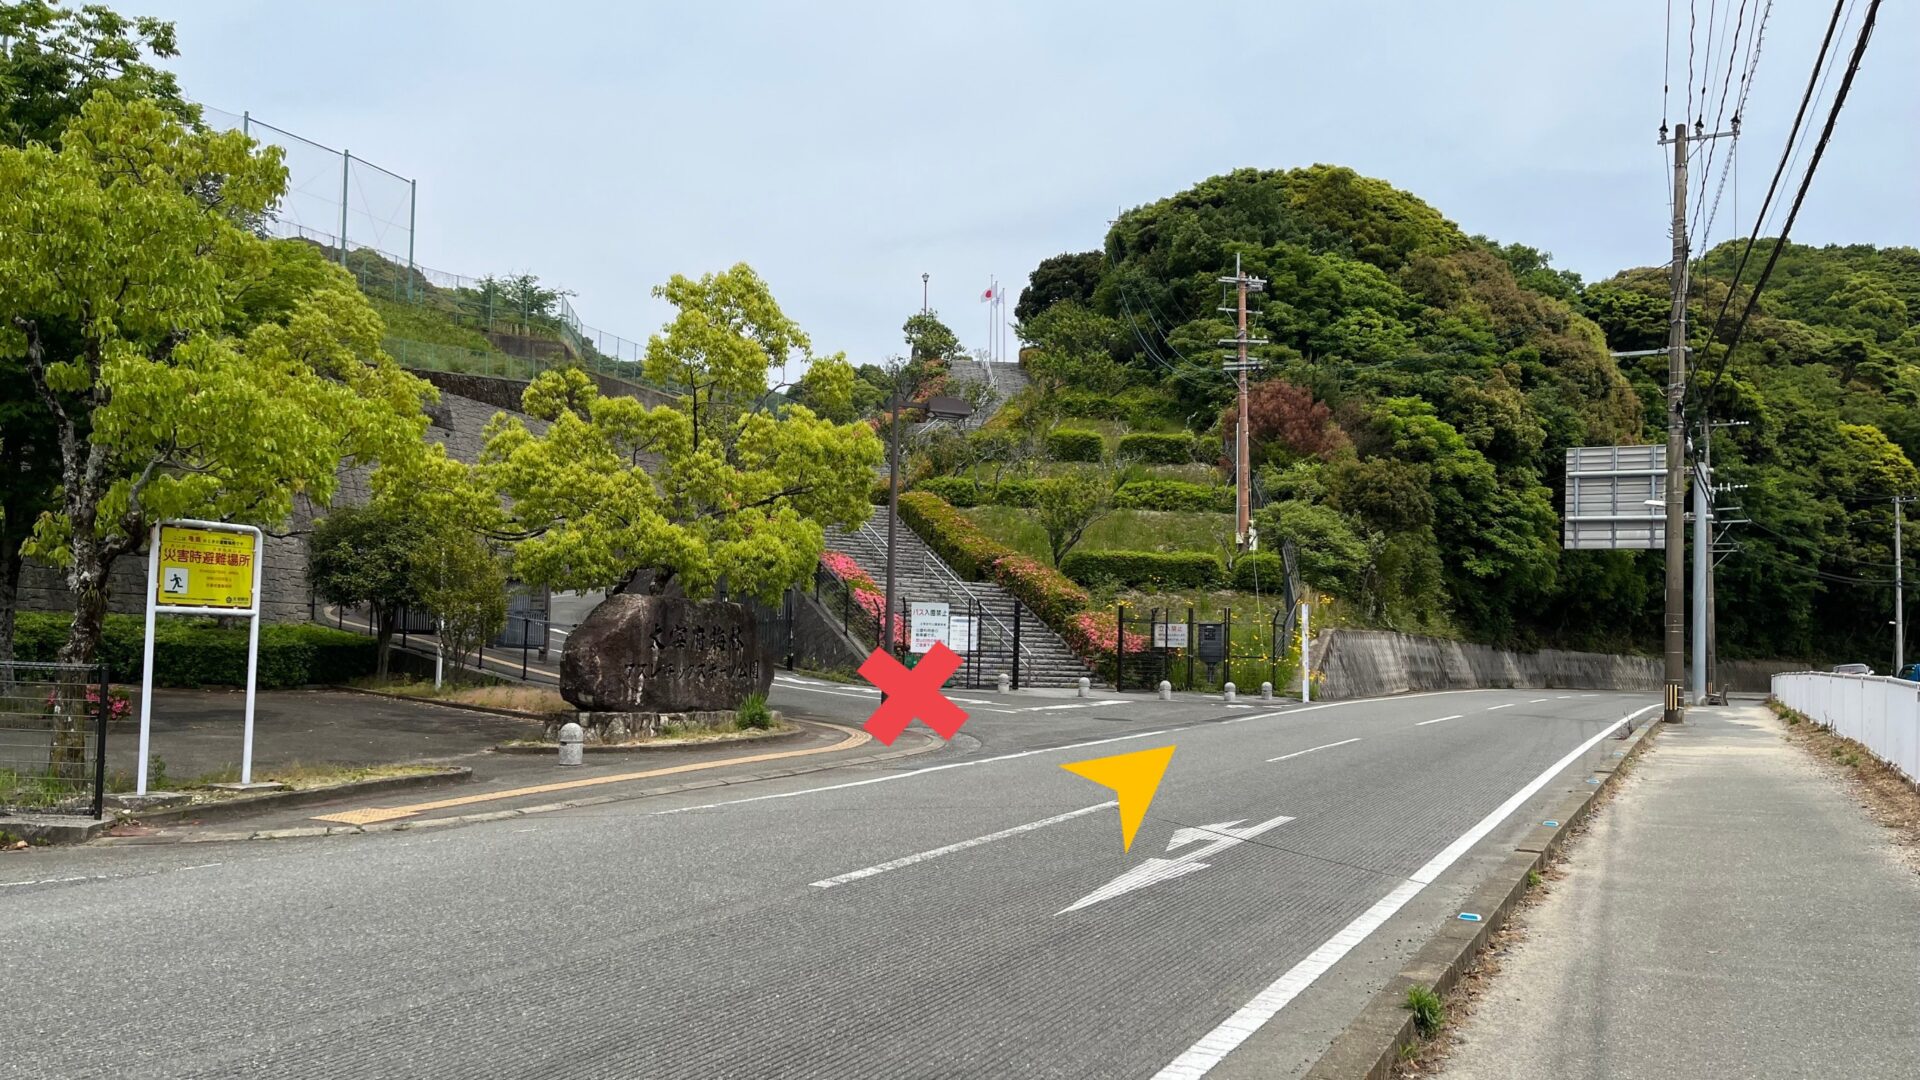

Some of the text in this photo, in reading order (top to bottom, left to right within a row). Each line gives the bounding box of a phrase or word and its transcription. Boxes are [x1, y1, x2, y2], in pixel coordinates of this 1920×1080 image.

[163, 548, 250, 567] 災害時避難場所
